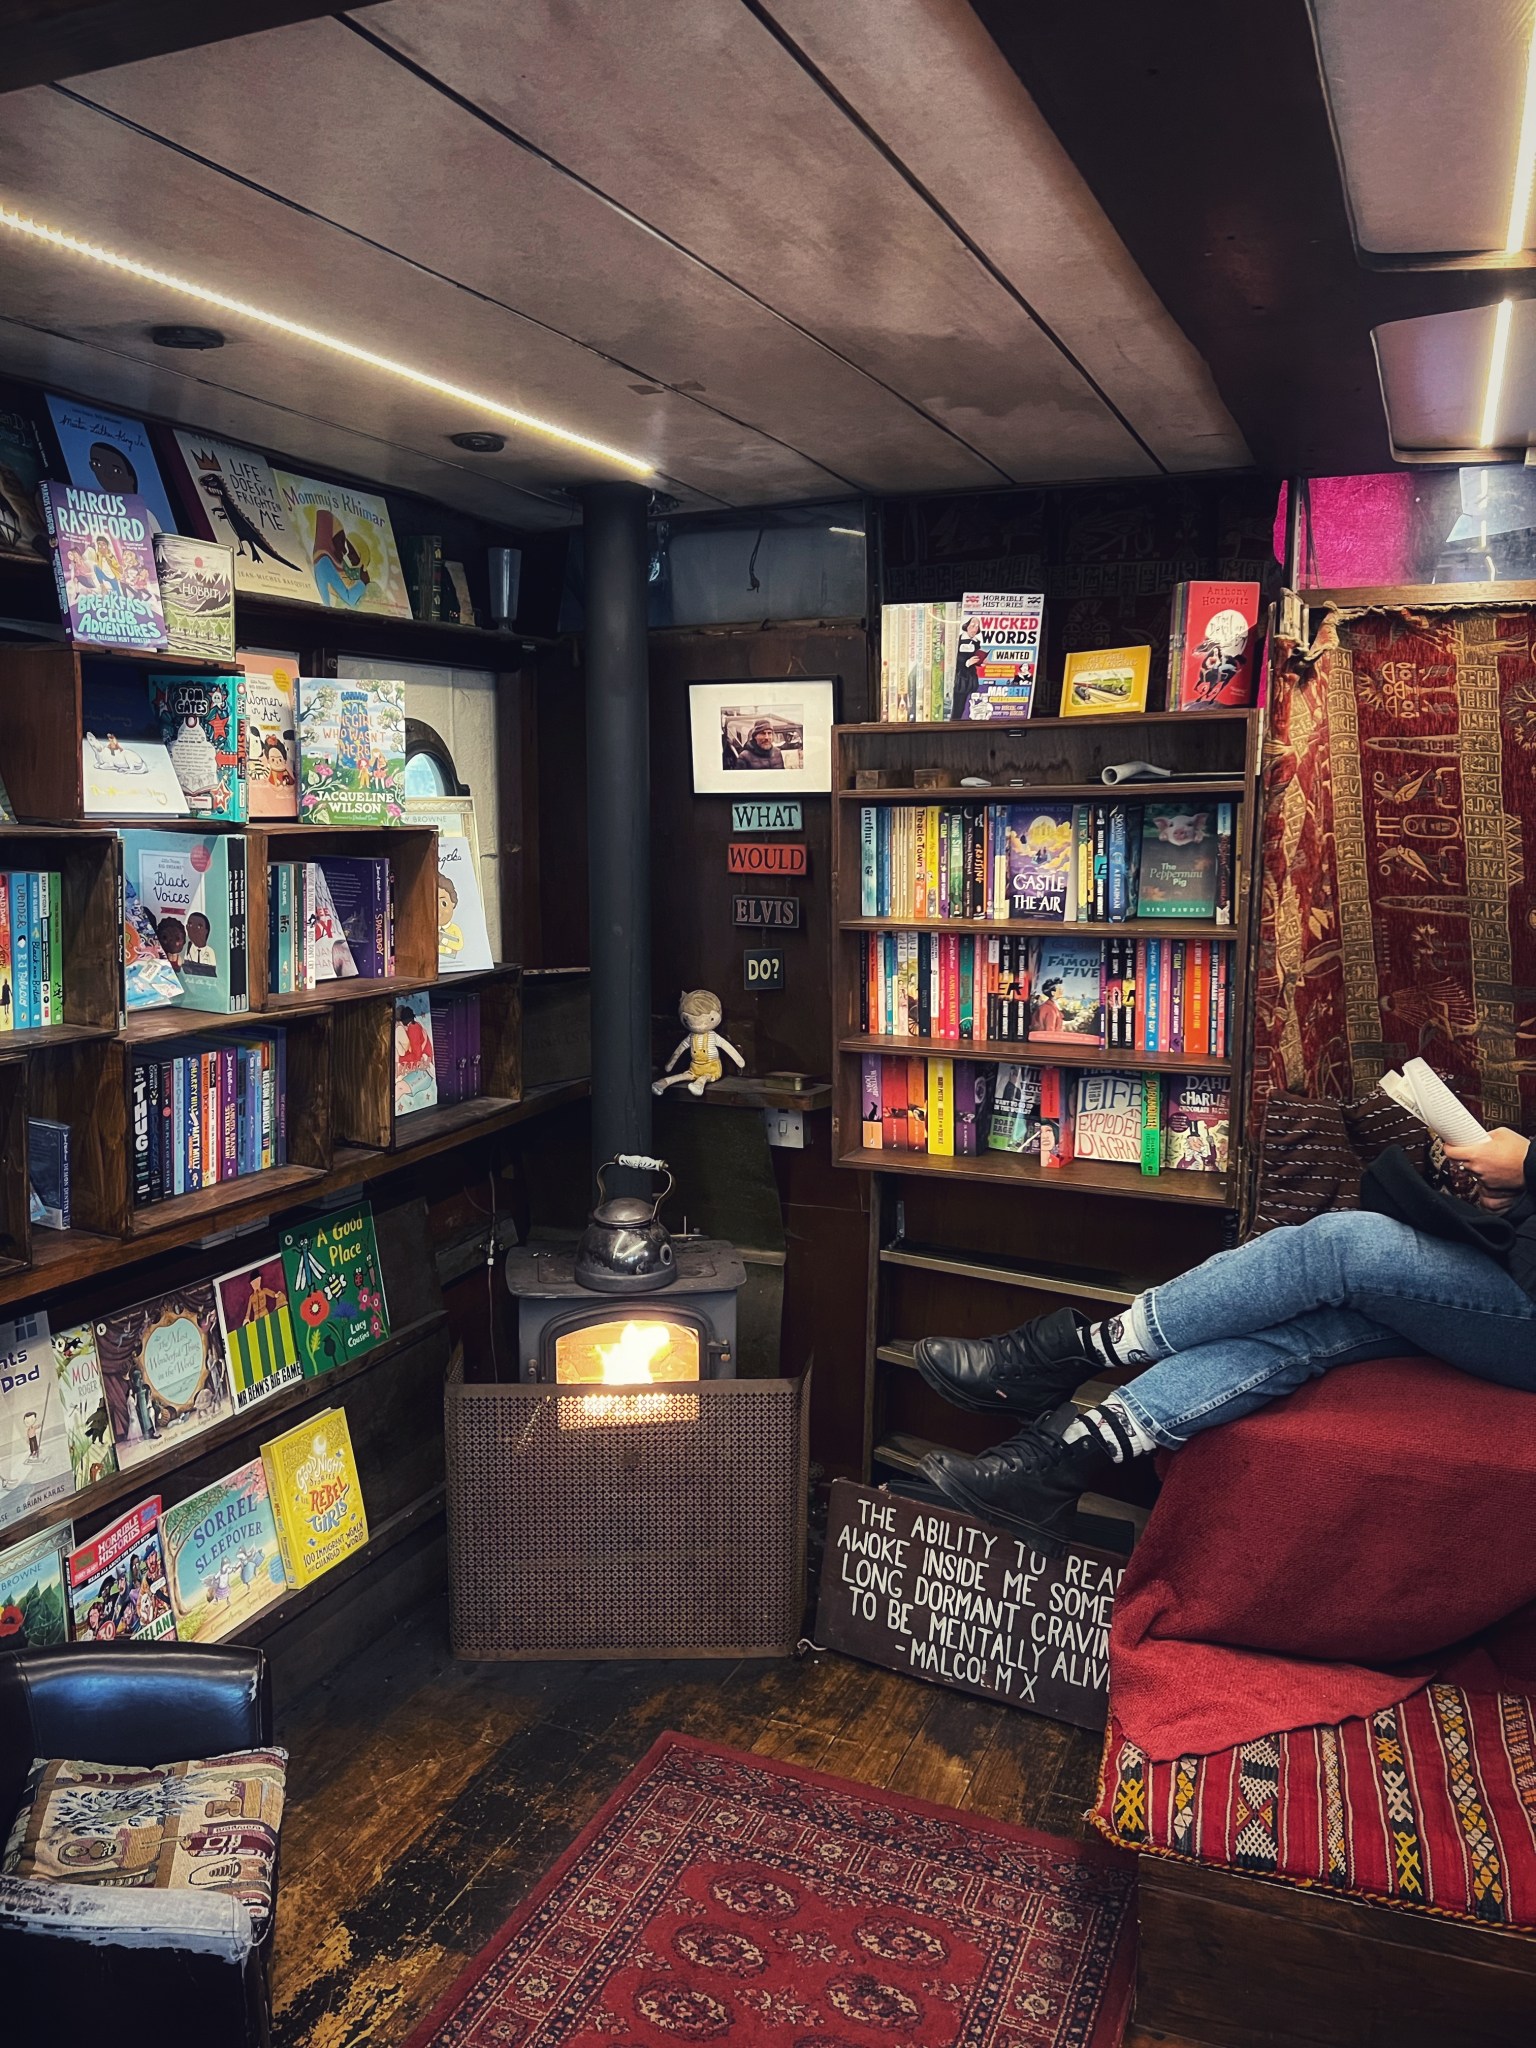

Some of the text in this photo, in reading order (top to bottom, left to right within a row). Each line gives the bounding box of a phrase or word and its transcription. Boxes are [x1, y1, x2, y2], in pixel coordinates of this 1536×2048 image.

[229, 458, 261, 483] LIFE
[230, 474, 274, 498] DOESN'T
[66, 487, 127, 517] MARCUS
[235, 489, 283, 513] FRIGHTEN
[281, 486, 386, 528] Mommy's Khimar
[57, 506, 145, 542] RASHFORD
[259, 508, 286, 531] ME
[181, 582, 219, 601] HOBBIT
[1202, 596, 1250, 607] Horowitz
[1207, 586, 1248, 596] Anthony
[77, 593, 155, 619] BREAKFAST
[96, 607, 138, 625] CLUB
[77, 613, 162, 639] ADVENTURES
[980, 617, 1039, 631] WICKED
[981, 631, 1037, 645] WORDS
[996, 650, 1030, 660] WANTED
[178, 686, 204, 701] TOM
[988, 686, 1030, 697] MACBETH
[174, 699, 209, 716] GATES
[261, 708, 281, 723] Art
[333, 712, 374, 728] THE GIRL
[322, 727, 385, 744] WHO WASN'T
[335, 743, 371, 760] THERE
[316, 790, 395, 803] JACQUELINE
[328, 801, 382, 815] WILSON
[412, 815, 448, 824] BROWNE
[734, 805, 799, 827] WHAT
[864, 810, 873, 844] arthur
[917, 810, 925, 867] Treacle Town
[951, 815, 961, 856] RAGING STAR
[1114, 814, 1124, 845] SKANDAR
[730, 846, 805, 870] WOULD
[154, 872, 190, 889] Black
[1013, 874, 1066, 893] CASTLE
[1150, 868, 1203, 881] Peppermint
[1173, 878, 1187, 887] Pig
[16, 884, 27, 929] WONDER
[153, 886, 190, 904] Voices
[1013, 895, 1063, 914] THE AIR
[735, 899, 794, 924] ELVIS
[280, 915, 289, 933] BFG
[375, 914, 384, 955] SPACEBOY
[32, 941, 40, 1004] Black British
[748, 958, 780, 982] DO?
[1048, 956, 1101, 967] FAMOU
[1062, 968, 1100, 978] FIVE
[1148, 983, 1156, 1019] BILLIONAIRE
[190, 1068, 198, 1095] HARRY
[262, 1070, 270, 1098] NELSON
[870, 1070, 879, 1097] WATERSHIP
[1186, 1076, 1231, 1091] DAHL
[995, 1099, 1010, 1107] WANT
[1080, 1079, 1142, 1113] LIFE
[1146, 1080, 1158, 1128] DARKMOUTH
[1180, 1091, 1227, 1107] CHARLIE
[133, 1081, 149, 1151] THUG
[1122, 1108, 1142, 1118] AN
[1078, 1112, 1142, 1140] EXPLODED
[1077, 1132, 1142, 1160] DIAGRAM
[317, 1211, 363, 1248] A Good
[329, 1242, 362, 1267] Place
[166, 1328, 189, 1347] Most
[347, 1330, 370, 1347] Cousins
[350, 1319, 367, 1335] Lucy
[147, 1348, 182, 1372] Wonderful
[173, 1356, 196, 1375] World
[1, 1365, 40, 1393] Dad
[237, 1361, 302, 1409] MR BENN'S BIG GAME
[296, 1454, 316, 1495] GOOD
[315, 1452, 346, 1478] NIGHT
[309, 1472, 336, 1488] STORIES
[23, 1484, 65, 1512] BRIAN KARAS
[309, 1475, 350, 1516] REBEL
[193, 1493, 258, 1549] SORREL
[305, 1498, 349, 1533] GIRLS
[98, 1514, 139, 1556] HORRIBLE
[858, 1499, 897, 1532] THE
[911, 1515, 998, 1559] ABILITY
[98, 1525, 141, 1566] HISTORIES
[195, 1521, 263, 1575] SLEEPOVER
[303, 1517, 364, 1568] 100 IMMIGRANT WOMEN
[1, 1562, 43, 1592] BROWNE
[837, 1525, 1115, 1629] AWOKE INSIDE ME SOME
[842, 1553, 1110, 1661] LONG DORMANT CRAVIN
[849, 1585, 1110, 1693] TO BE MENTALLY ALIV
[1019, 1673, 1039, 1703] X
